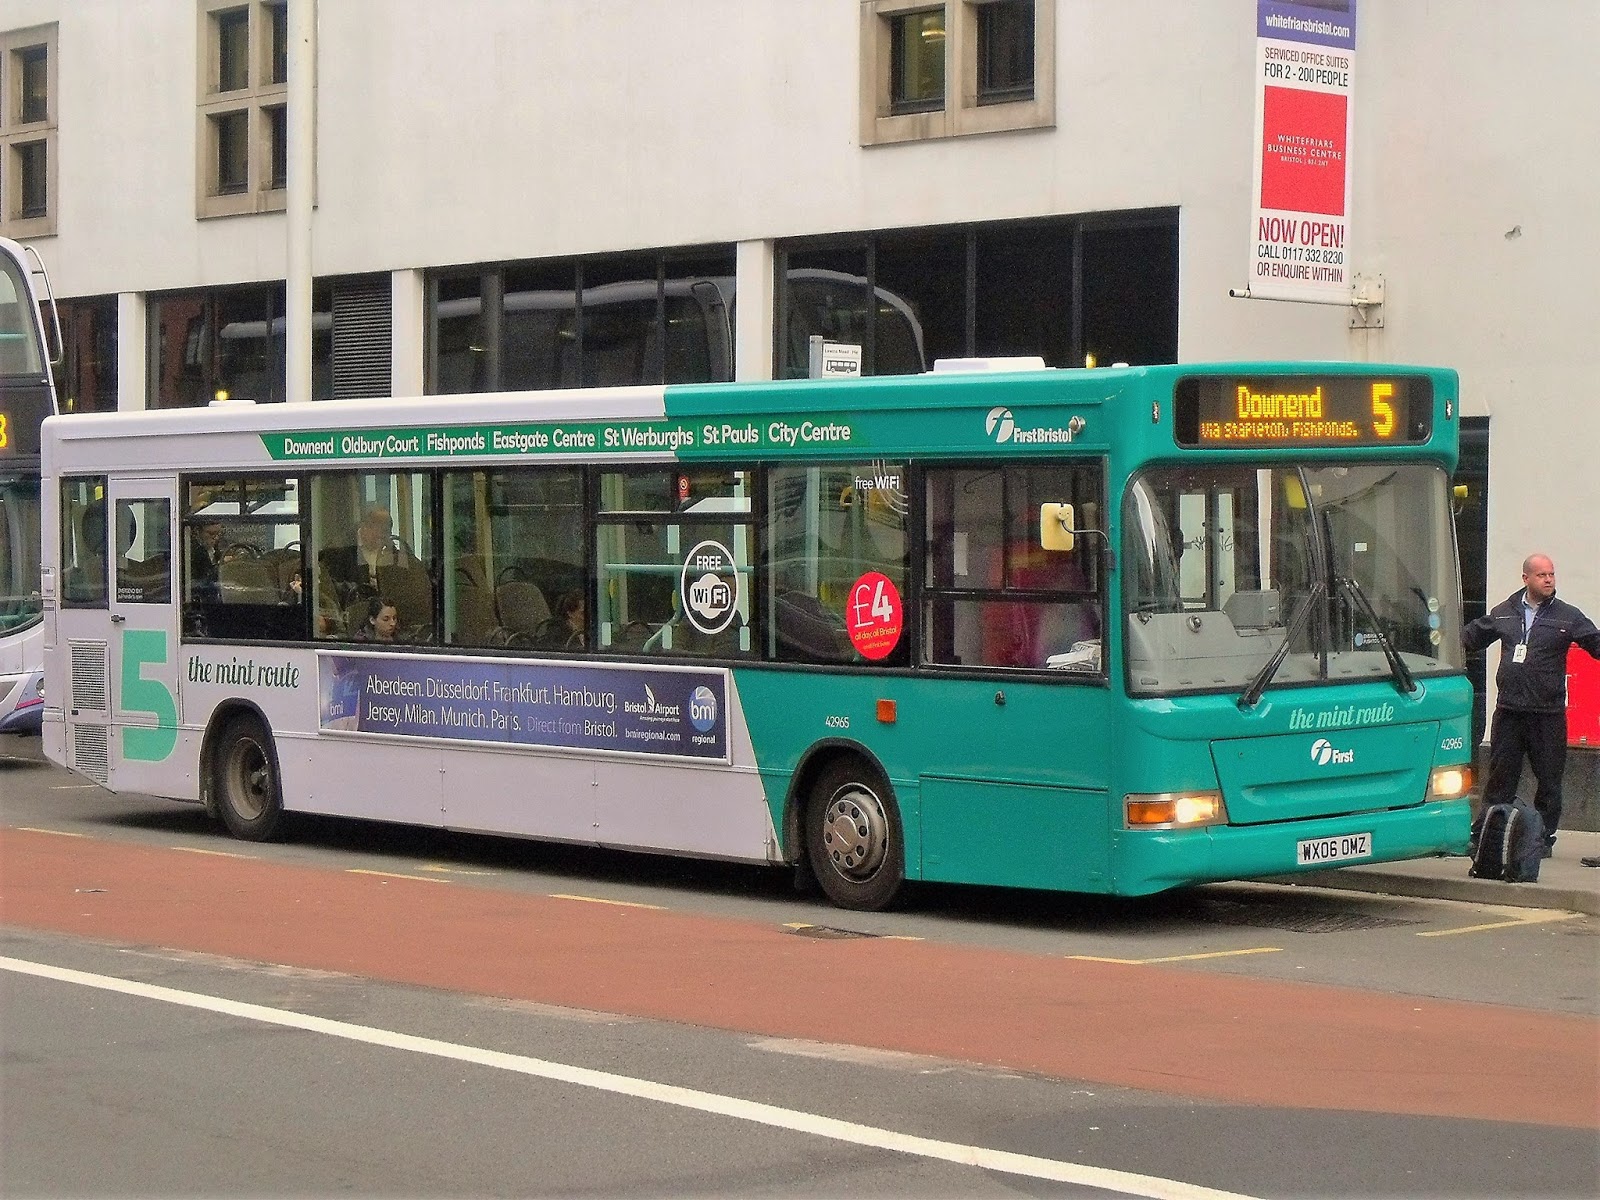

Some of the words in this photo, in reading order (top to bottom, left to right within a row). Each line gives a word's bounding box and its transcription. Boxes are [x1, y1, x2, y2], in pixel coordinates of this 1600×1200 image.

[1266, 14, 1350, 38] whitefriarsbristol.com
[1265, 47, 1300, 62] SERVICED
[1301, 52, 1324, 66] OFFICE
[1326, 56, 1348, 70] SUITES
[1264, 62, 1282, 78] FOR
[1285, 65, 1290, 79] 2
[1298, 67, 1314, 82] 200
[1316, 69, 1348, 87] PEOPLE
[1278, 134, 1333, 148] WHITEFRIARS
[1268, 144, 1306, 156] BUSINESS
[1310, 149, 1342, 160] CENTRE
[1281, 156, 1302, 164] BRISTOL
[1259, 217, 1297, 243] NOW
[1301, 221, 1344, 248] OPEN!
[1258, 244, 1280, 259] CALL
[1282, 247, 1303, 260] 0117
[1305, 249, 1320, 262] 332
[1323, 250, 1343, 264] 8230
[1257, 262, 1269, 276] OR
[1272, 263, 1310, 279] ENQUIRE
[1312, 266, 1343, 282] WITHIN
[1238, 386, 1322, 418] Downend
[1372, 384, 1393, 436] 5
[284, 437, 334, 454] Downend
[342, 436, 385, 456] Oldbury
[386, 435, 419, 452] Court
[427, 432, 485, 454] Fishponds
[493, 430, 548, 452] Eastgate
[553, 429, 595, 447] Centre
[604, 428, 620, 446] St
[621, 426, 694, 450] Werburghs
[703, 425, 720, 444] St
[722, 423, 759, 444] Pauls
[769, 422, 799, 447] City
[801, 421, 850, 442] Centre
[855, 476, 873, 490] free
[874, 476, 899, 490] WiFi
[697, 556, 721, 570] FREE
[853, 581, 893, 628] £4
[188, 656, 212, 682] the
[216, 656, 255, 685] mint
[258, 662, 299, 688] route
[121, 630, 178, 762] 5
[366, 674, 424, 697] Aberdeen.
[426, 677, 490, 701] Düsseldorf.
[494, 681, 550, 704] Frankfurt.
[554, 685, 617, 714] Hamburg.
[366, 701, 402, 727] Jersey.
[405, 703, 438, 724] Milan.
[441, 706, 488, 728] Munich.
[491, 709, 521, 731] Paris.
[527, 716, 556, 733] Direct
[558, 717, 581, 734] from
[584, 720, 617, 738] Bristol.
[624, 702, 646, 713] Bristol
[655, 703, 679, 717] Airport
[691, 701, 714, 720] bmi
[1289, 708, 1314, 729] the
[1316, 705, 1355, 728] mint
[1356, 702, 1394, 724] route
[825, 716, 850, 728] 42965
[625, 728, 680, 742] bmiregional.com
[692, 735, 716, 745] regional
[1441, 737, 1463, 750] 42965
[1332, 749, 1354, 764] First
[1303, 840, 1337, 861] WX06
[1342, 836, 1366, 855] OMZ
